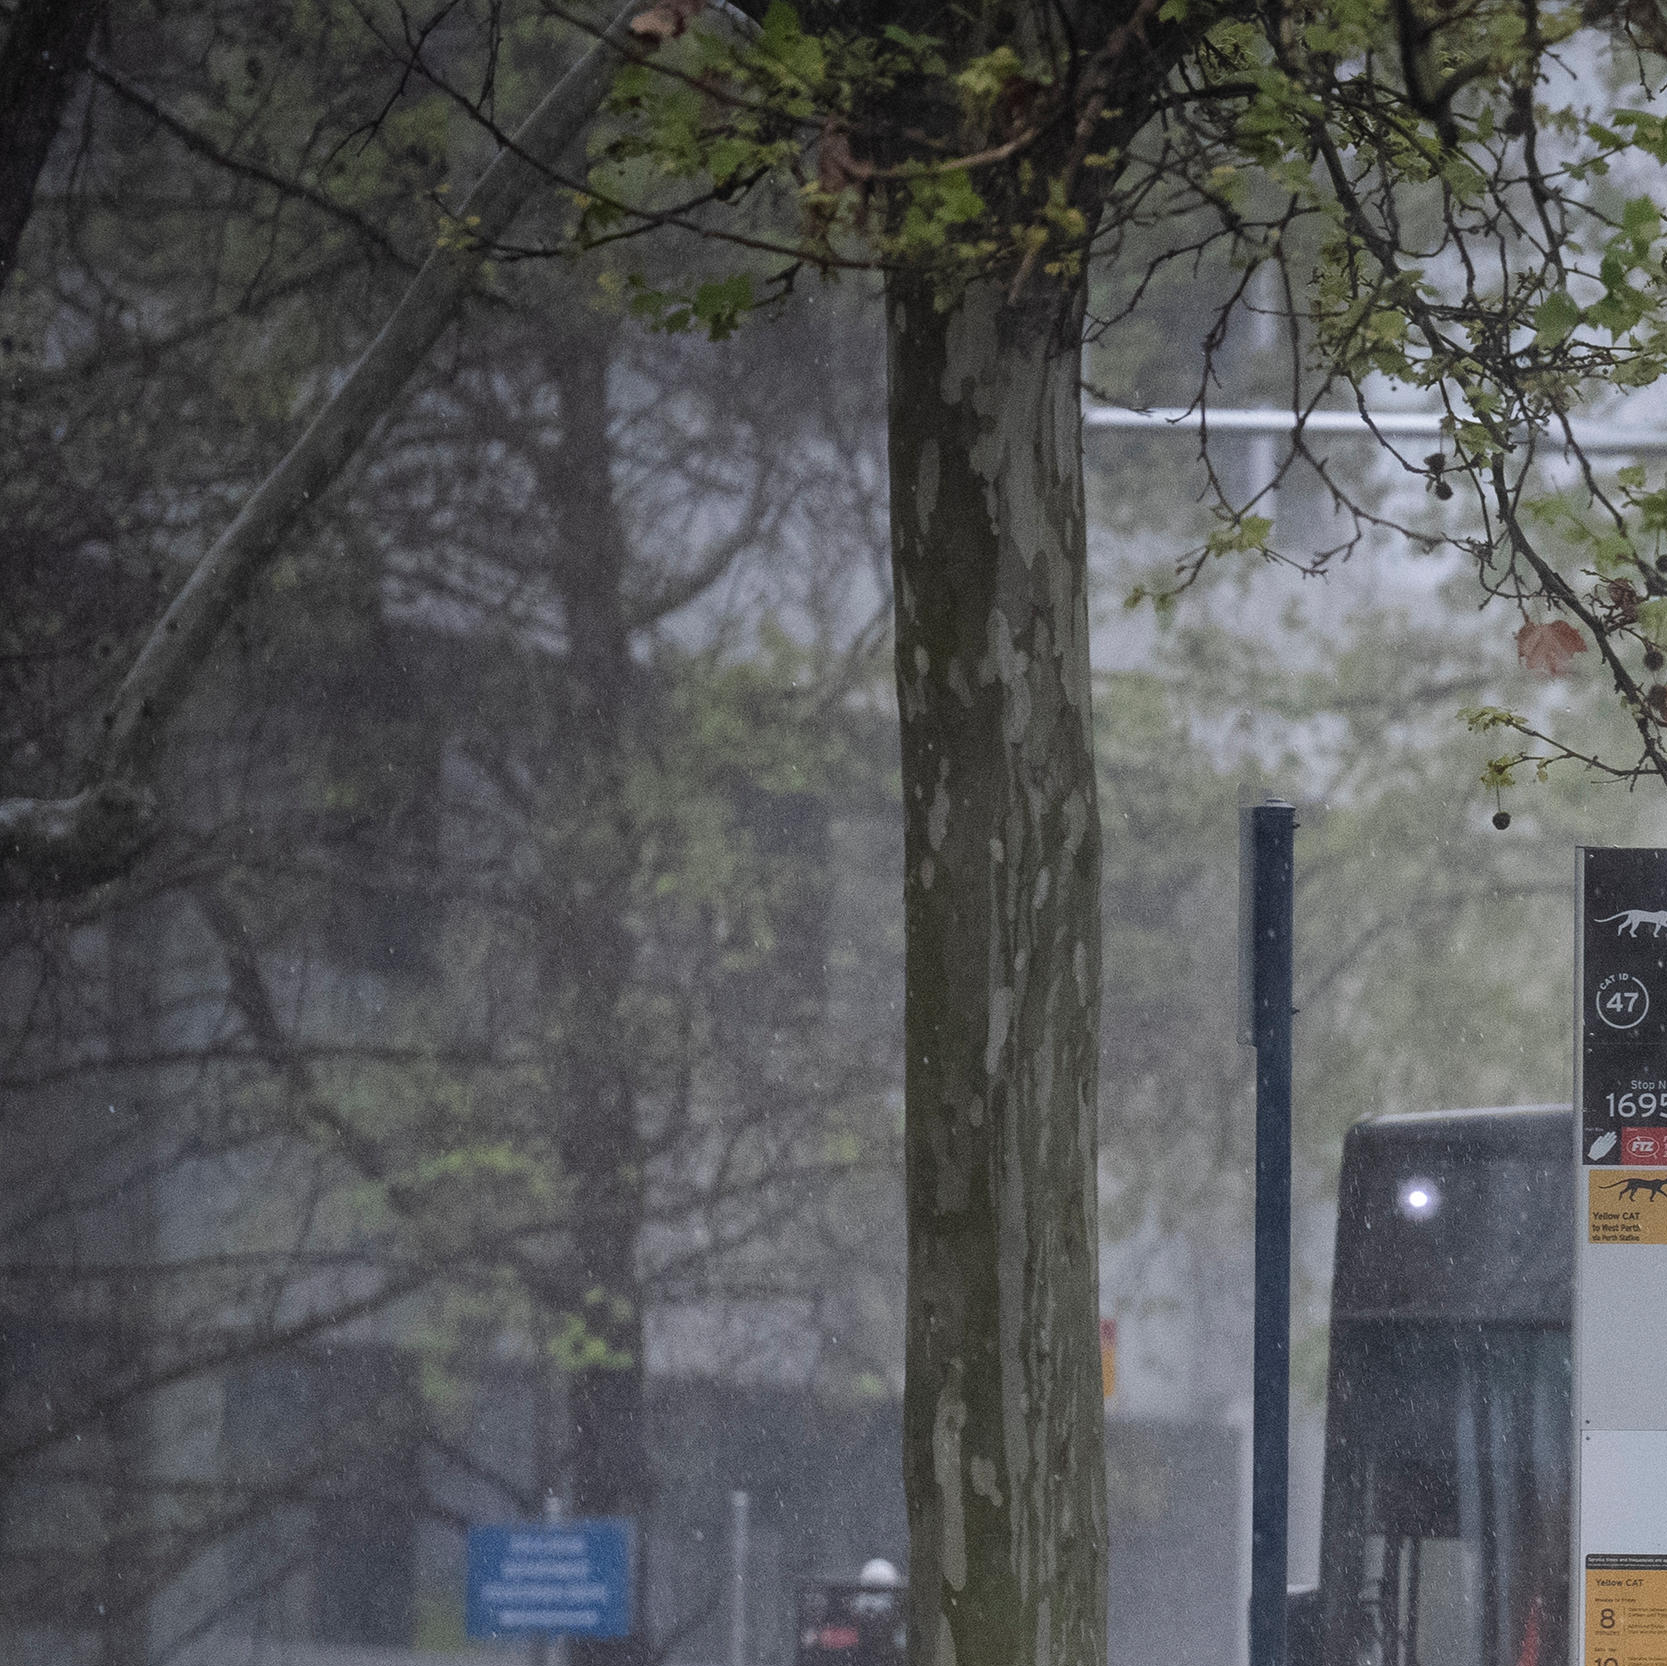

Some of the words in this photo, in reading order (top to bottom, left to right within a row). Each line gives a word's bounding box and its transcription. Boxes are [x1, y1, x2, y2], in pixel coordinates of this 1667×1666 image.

[1600, 975, 1615, 990] CAT
[1619, 973, 1629, 981] ID
[1606, 992, 1639, 1013] 47
[1631, 1080, 1655, 1092] Stop
[1631, 1140, 1655, 1152] FTZ
[1593, 1212, 1620, 1220] Yellow
[1623, 1212, 1640, 1220] CAT
[1602, 1224, 1619, 1232] West
[1596, 1579, 1622, 1587] Yellow
[1625, 1579, 1644, 1587] CAT
[1600, 1608, 1615, 1629] 8
